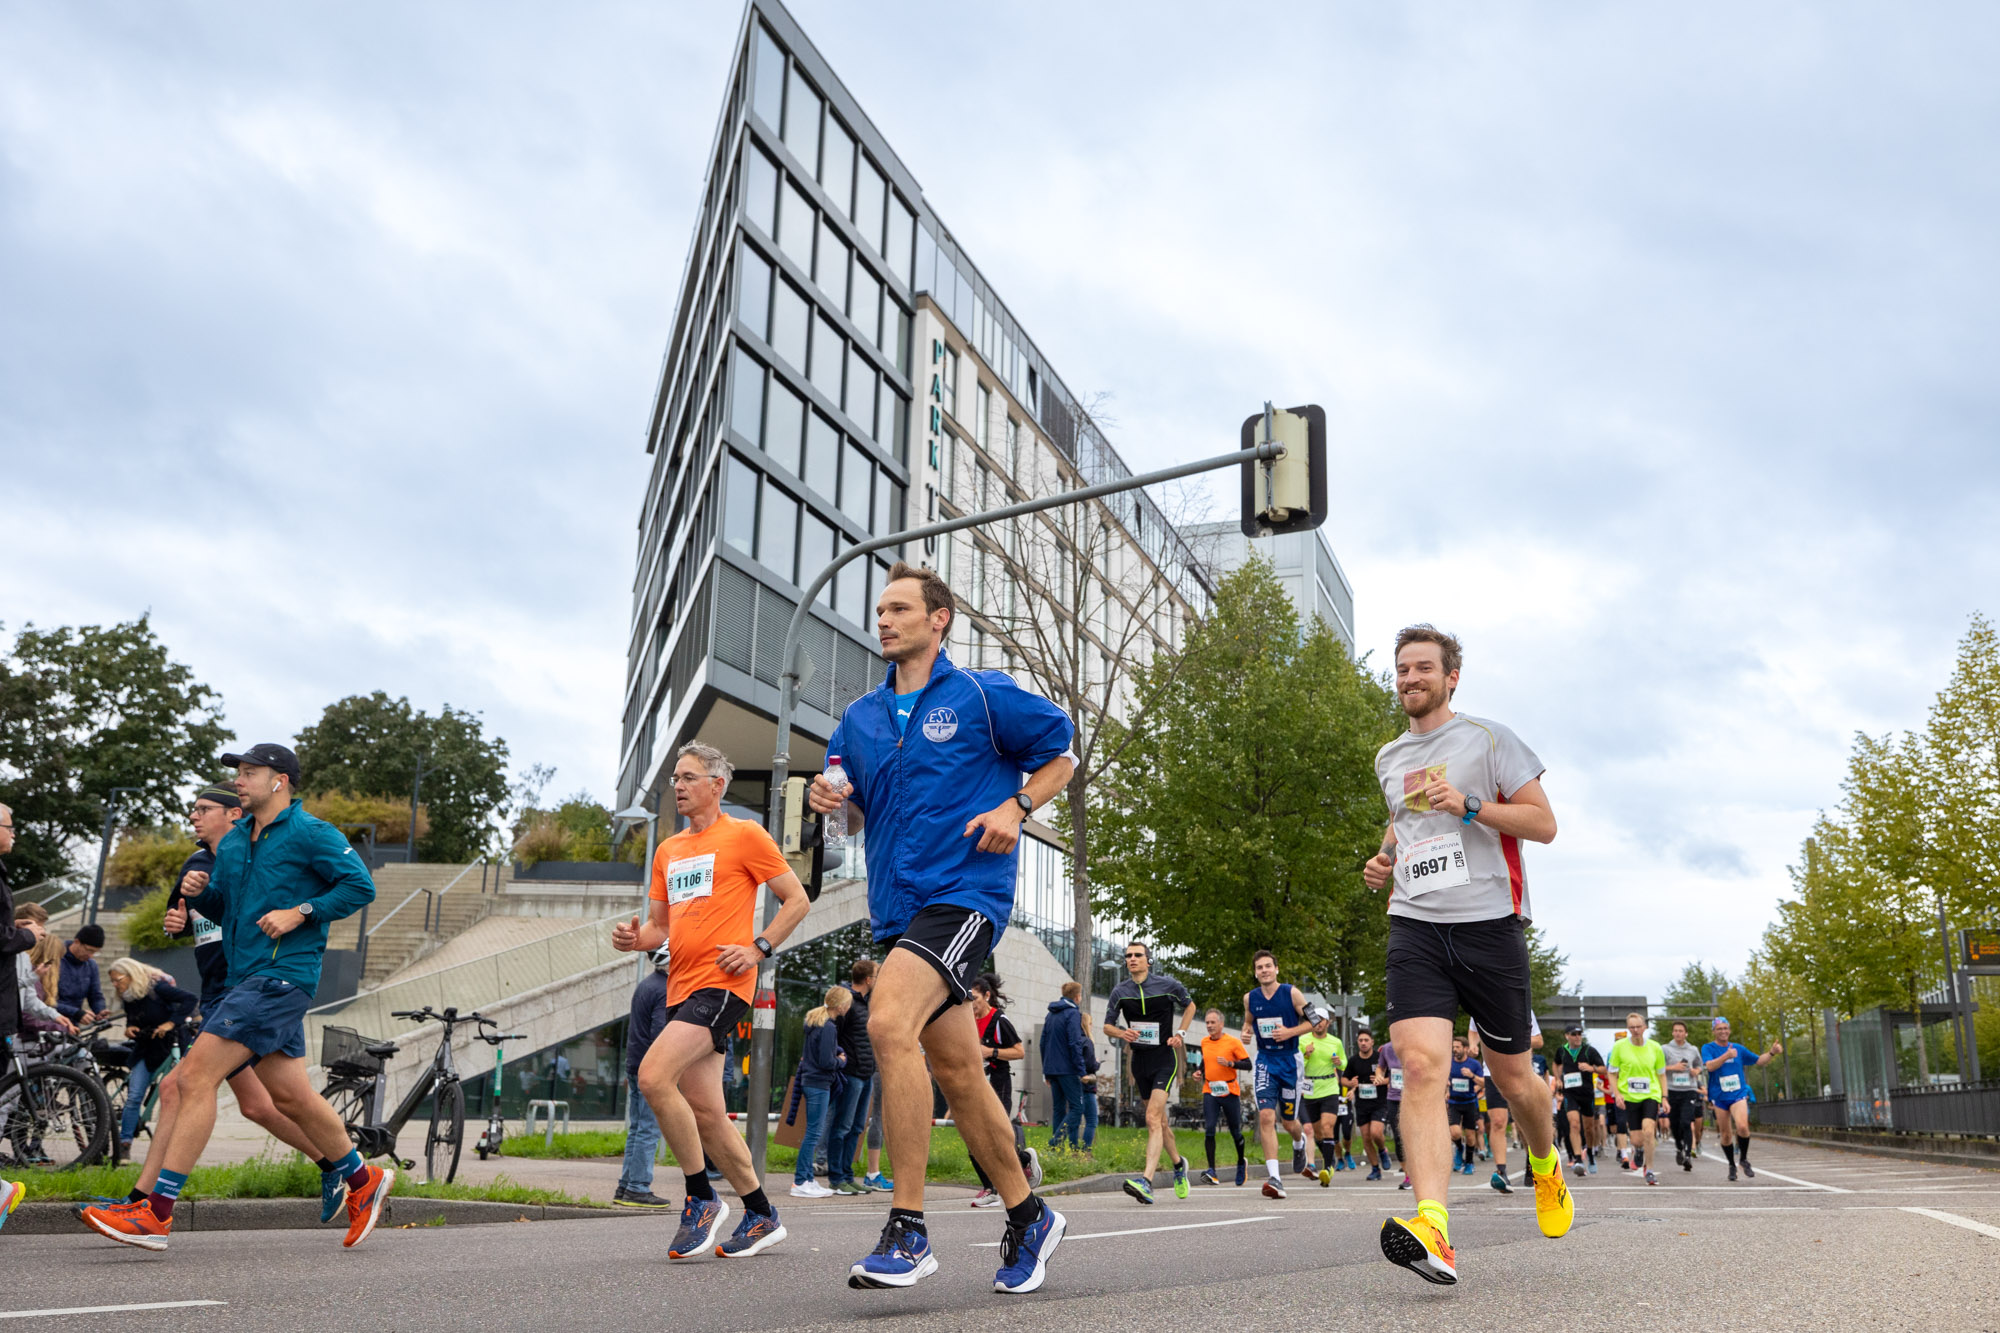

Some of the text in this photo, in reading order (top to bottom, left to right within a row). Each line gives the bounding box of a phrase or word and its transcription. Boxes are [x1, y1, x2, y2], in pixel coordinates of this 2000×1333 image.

[929, 338, 944, 470] PARK
[929, 709, 953, 723] ESV
[1412, 855, 1448, 879] 9697
[676, 872, 702, 889] 1106
[1284, 1102, 1294, 1115] 2
